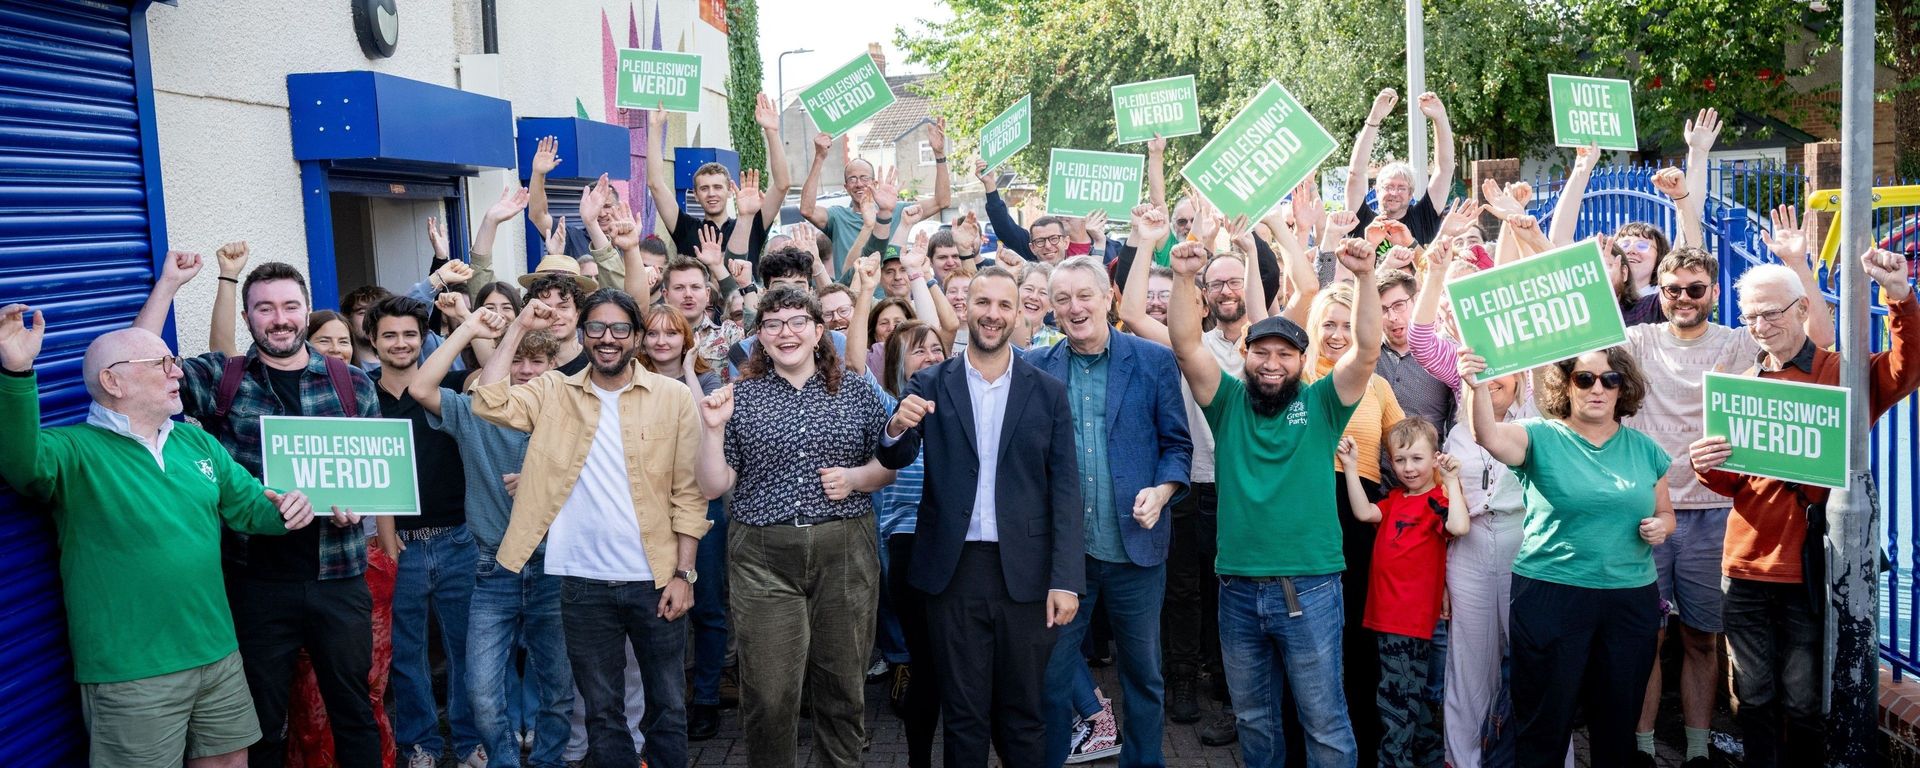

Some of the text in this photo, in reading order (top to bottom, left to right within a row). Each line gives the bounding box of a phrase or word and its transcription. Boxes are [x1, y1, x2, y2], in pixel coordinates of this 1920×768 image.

[622, 59, 698, 78] PLEIDLEISIWCH
[632, 73, 687, 97] WERDD
[807, 63, 875, 112] PLEIDLEISIWCH
[822, 81, 876, 122] WERDD
[1118, 86, 1192, 109] PLEIDLEISIWCH
[1570, 82, 1613, 109] VOTE
[982, 104, 1027, 147] PLEIDLEISIWCH
[1129, 101, 1184, 128] WERDD
[1568, 109, 1622, 137] GREEN
[988, 121, 1021, 158] WERDD
[1197, 97, 1294, 192] PLEIDLEISIWCH
[1055, 161, 1138, 182] PLEIDLEISIWCH
[1223, 126, 1302, 201] WERDD
[1065, 177, 1125, 203] WERDD
[1459, 260, 1600, 321] PLEIDLEISIWCH
[1484, 291, 1591, 349] WERDD
[1711, 391, 1840, 428] PLEIDLEISIWCH
[271, 434, 406, 457] PLEIDLEISIWCH
[1728, 415, 1821, 459] WERDD
[291, 457, 391, 489] WERDD
